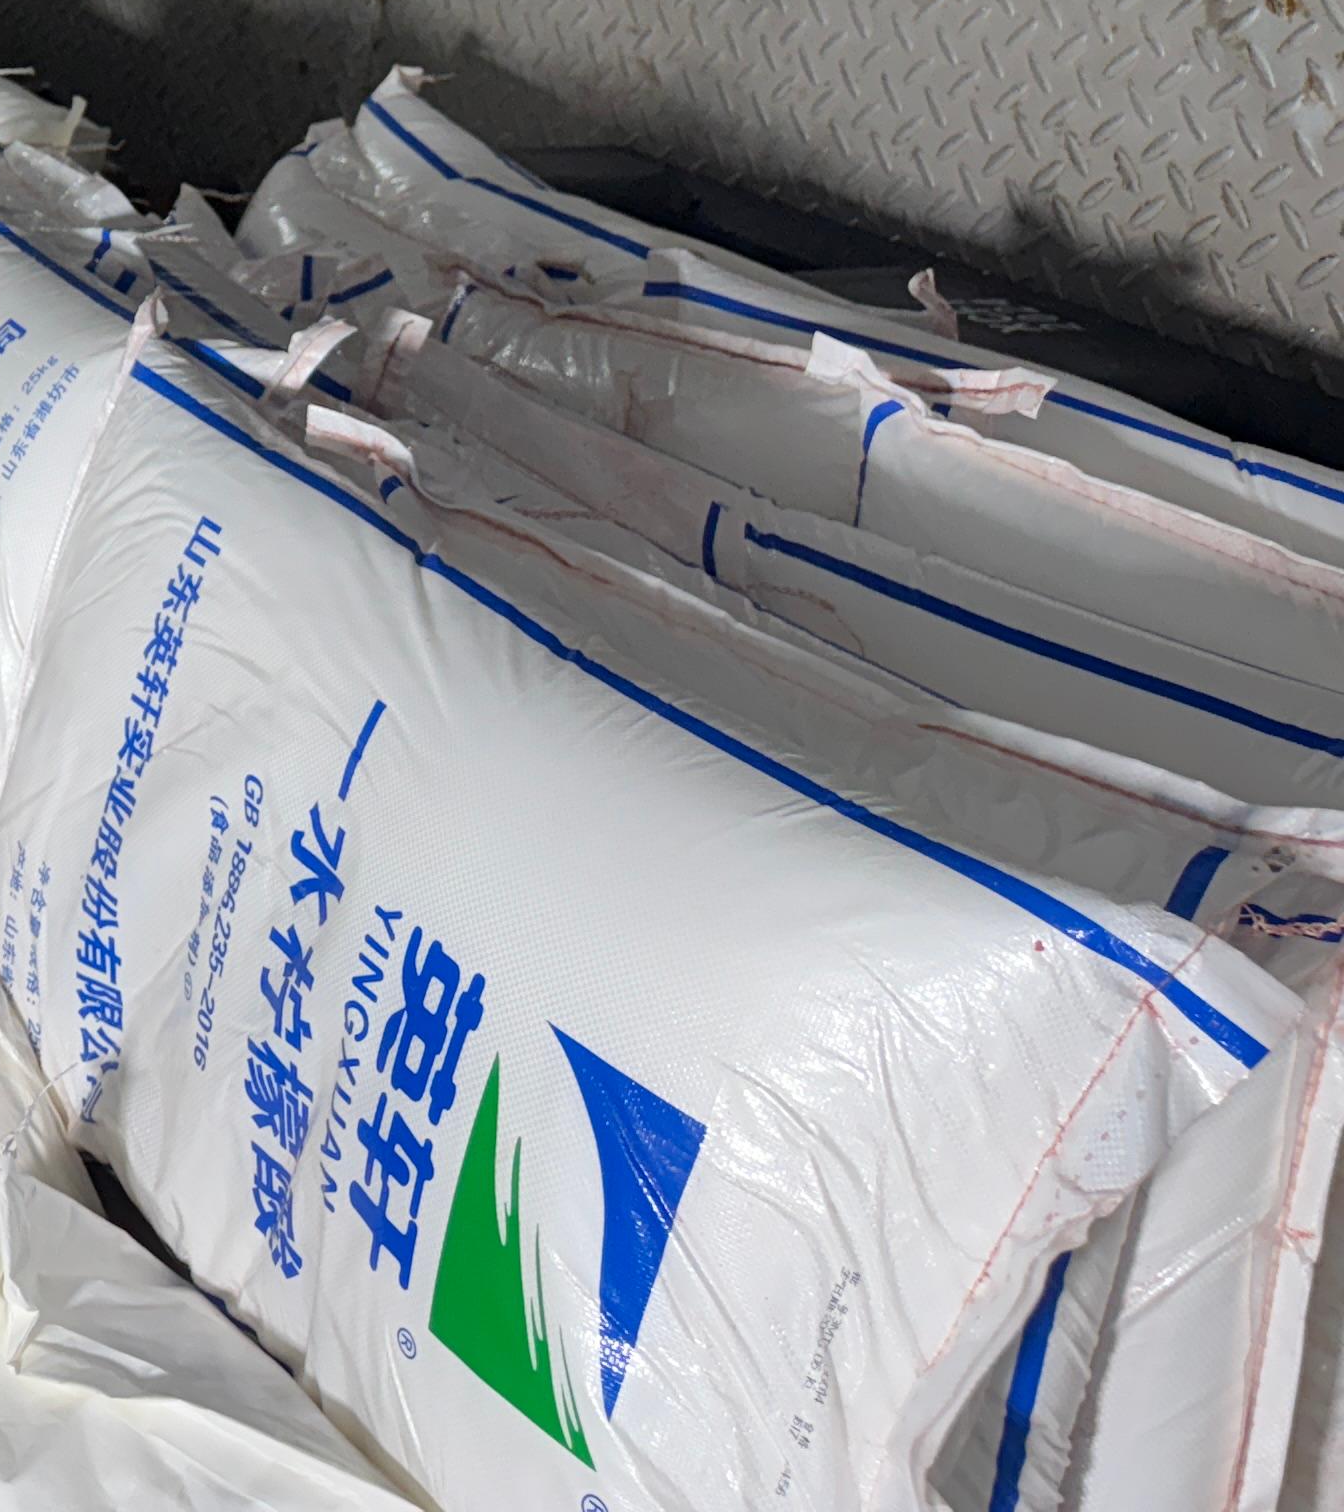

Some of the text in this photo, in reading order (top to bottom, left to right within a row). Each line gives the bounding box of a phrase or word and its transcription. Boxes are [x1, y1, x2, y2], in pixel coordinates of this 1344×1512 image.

[190, 774, 265, 1072] GB 1886.235-2016
[242, 698, 389, 1283] 一水柠檬酸
[317, 903, 404, 1216] YINGXUAN
[350, 925, 488, 1293] 英轩
